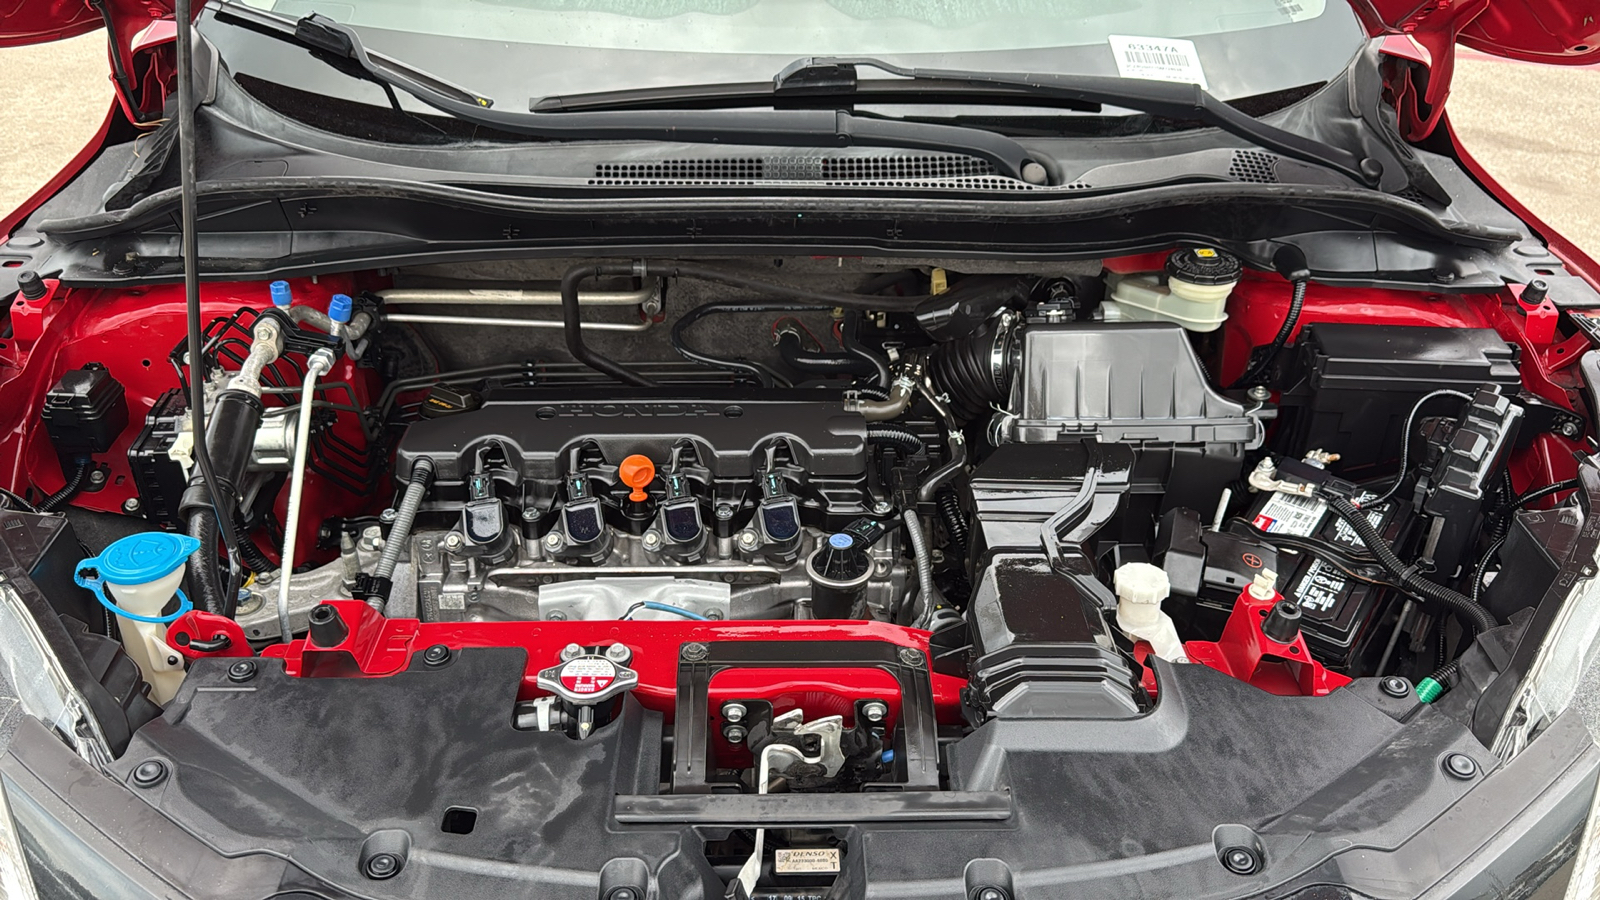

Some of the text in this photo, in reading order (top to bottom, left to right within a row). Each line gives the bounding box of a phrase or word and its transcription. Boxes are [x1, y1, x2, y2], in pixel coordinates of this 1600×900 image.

[558, 404, 720, 417] HONDA
[830, 851, 837, 860] X
[830, 861, 837, 869] T
